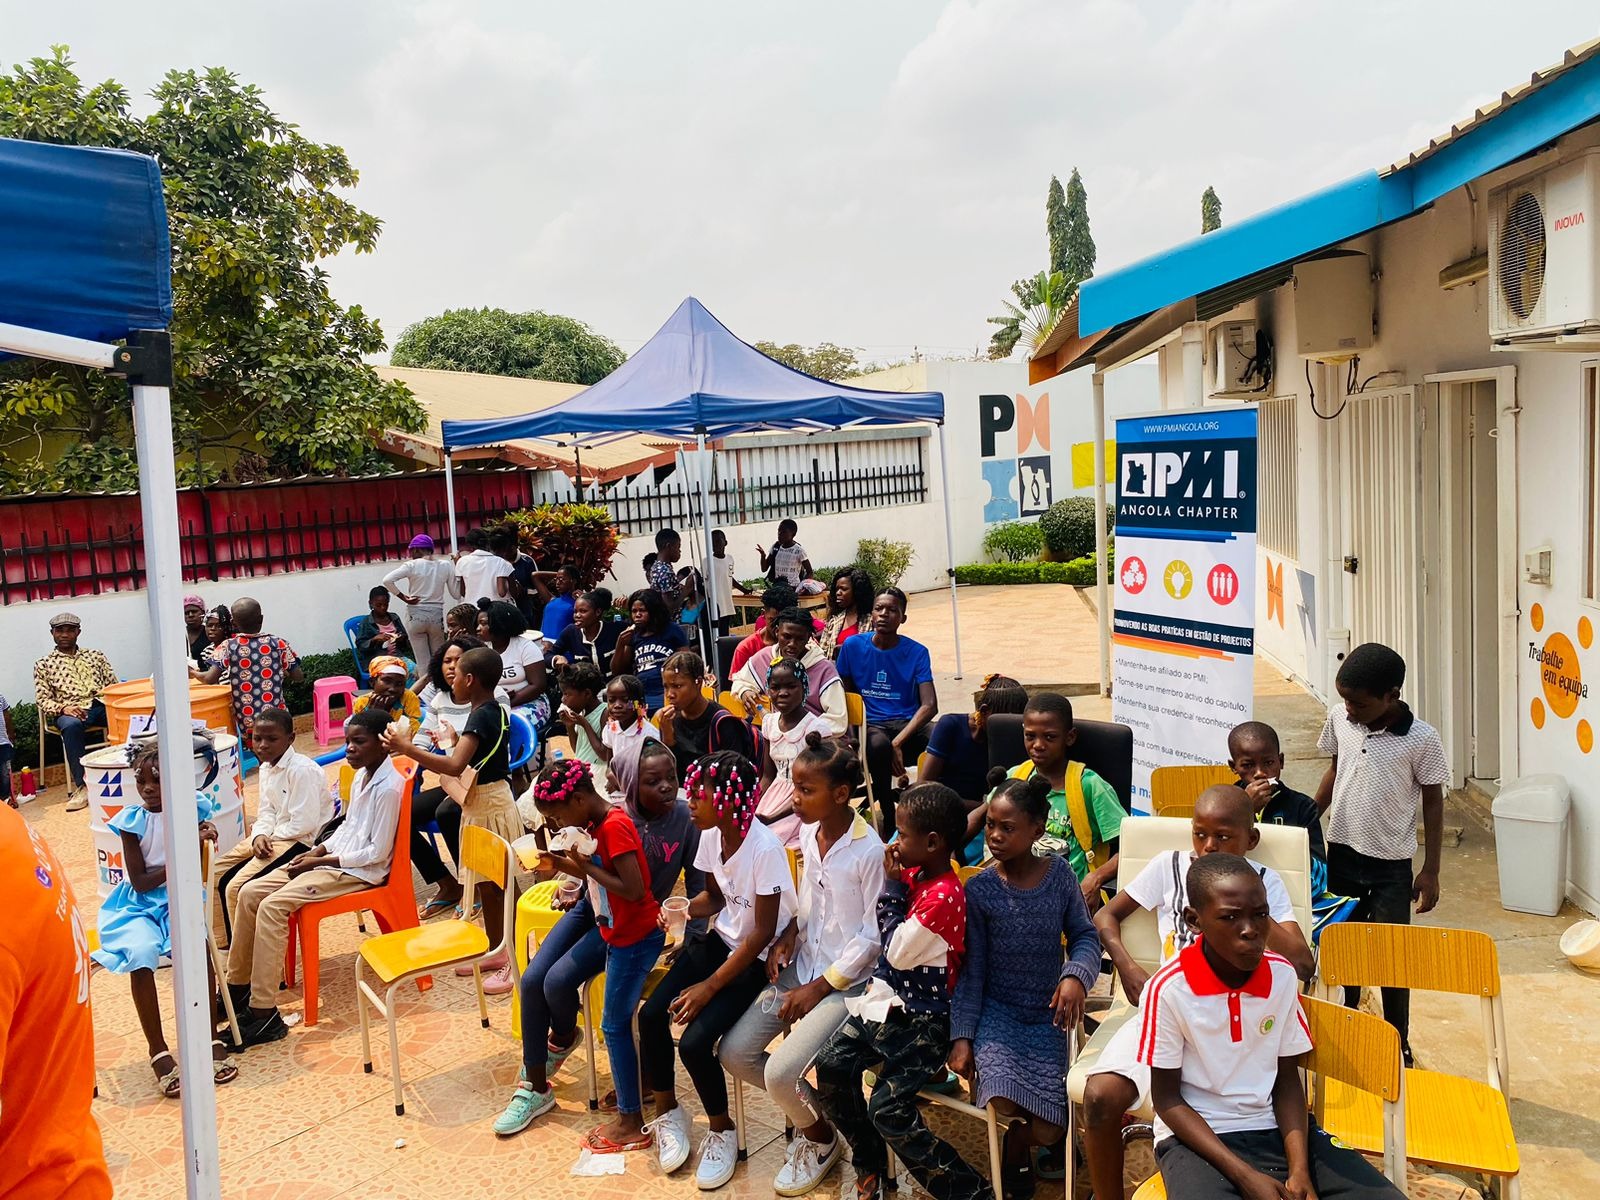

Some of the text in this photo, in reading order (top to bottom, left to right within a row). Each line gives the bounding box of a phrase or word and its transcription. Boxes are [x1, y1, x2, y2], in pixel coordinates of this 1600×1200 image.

[1143, 421, 1219, 434] WWW.PMIANGOLA.ORG
[1120, 504, 1238, 519] ANGOLA CHAPTER
[1141, 622, 1148, 631] AS
[1149, 624, 1160, 633] BOAS
[1213, 633, 1220, 643] DE
[1220, 634, 1252, 648] PROJECTOS
[1528, 642, 1564, 670] Trabalho
[1158, 666, 1182, 678] afiliado
[1183, 672, 1192, 680] ao
[1543, 668, 1589, 700] em equipa
[1156, 686, 1184, 698] membro
[1204, 696, 1215, 705] do
[1148, 704, 1160, 713] sua
[1161, 707, 1194, 721] credencial
[1146, 741, 1160, 751] com
[1161, 745, 1174, 755] sua
